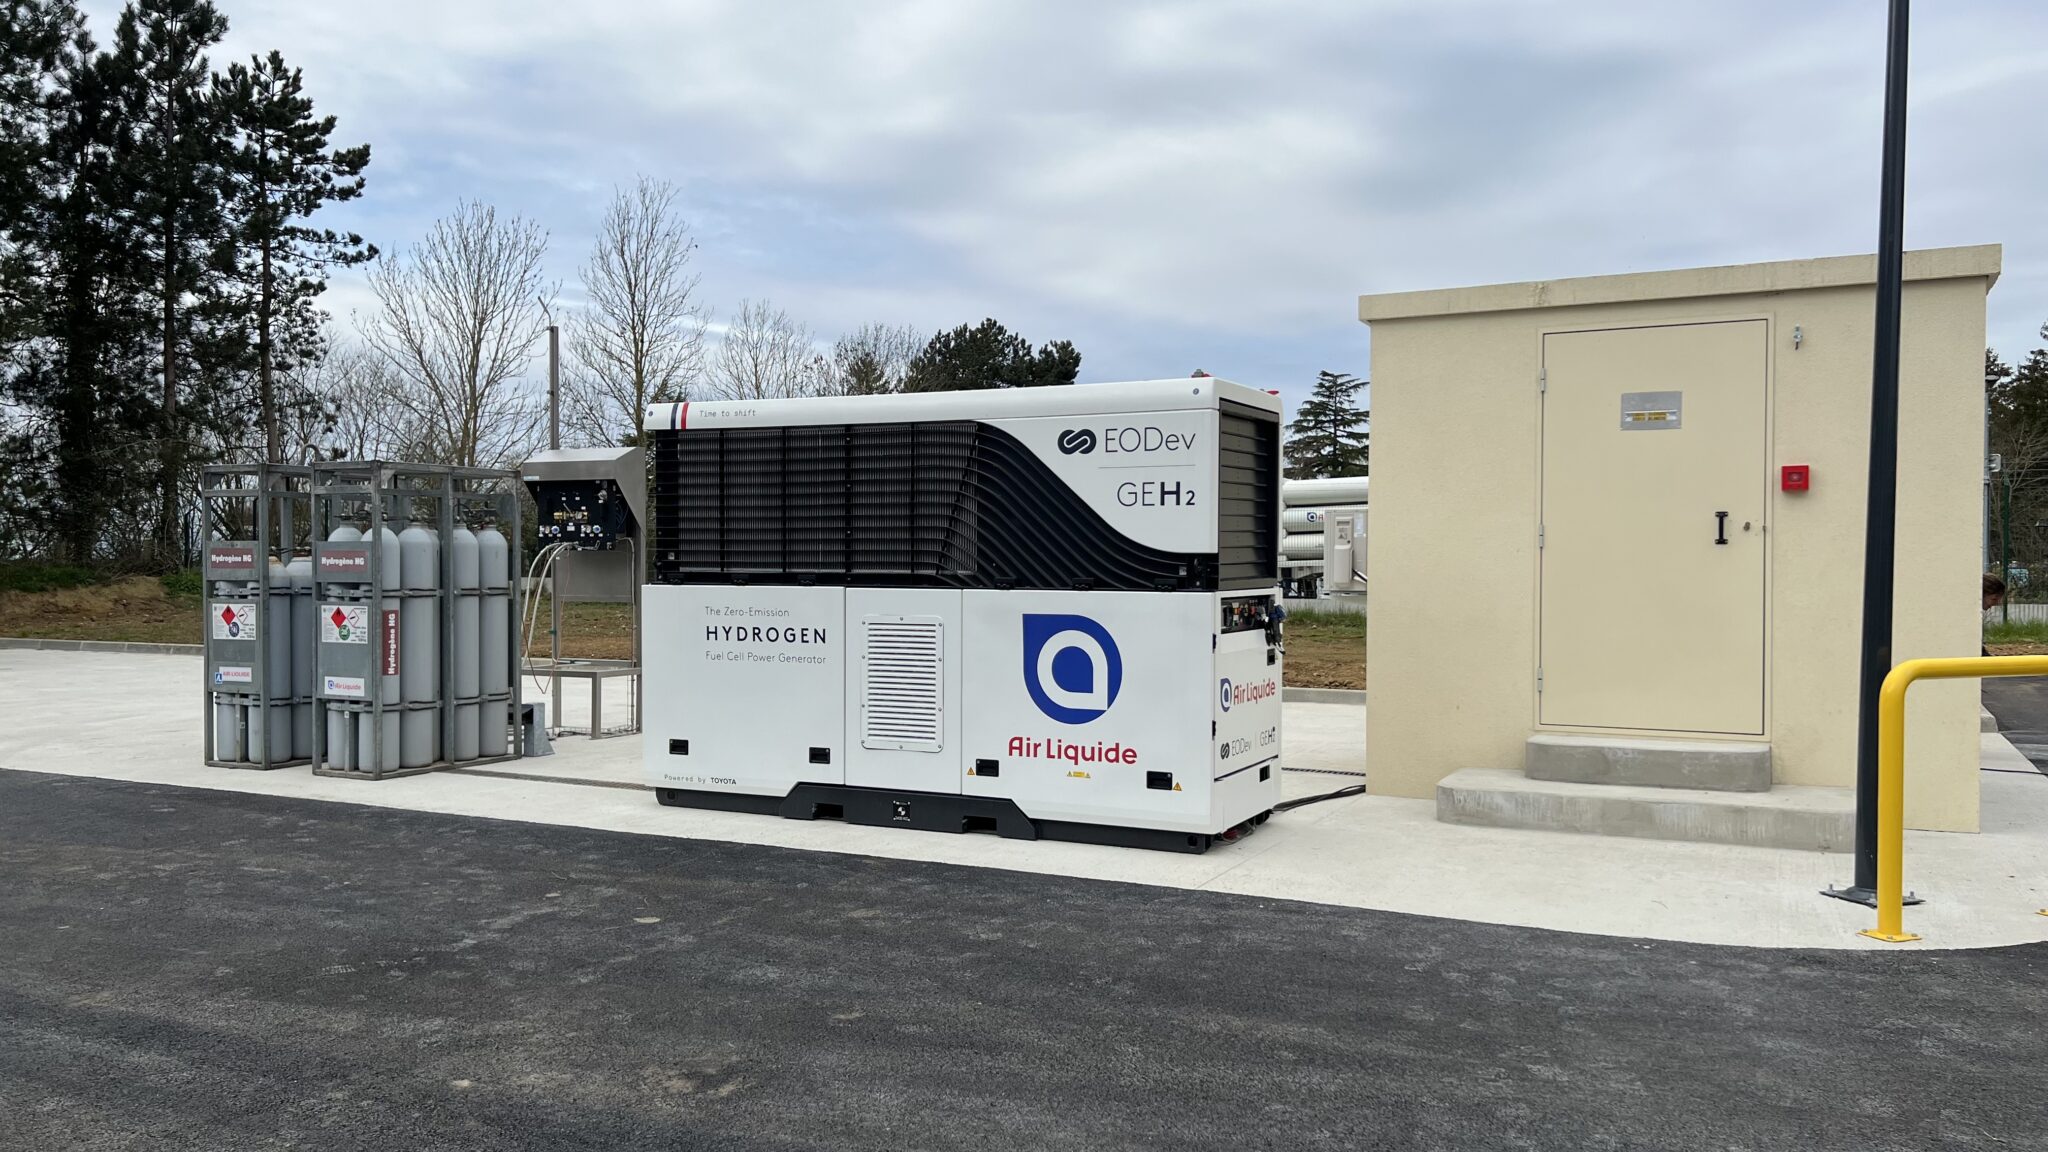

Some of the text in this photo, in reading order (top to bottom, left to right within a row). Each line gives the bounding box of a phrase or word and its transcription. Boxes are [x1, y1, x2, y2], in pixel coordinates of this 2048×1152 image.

[734, 409, 757, 417] shift
[1105, 426, 1196, 453] EODev
[1117, 481, 1196, 507] GEH2
[242, 554, 252, 562] HG
[354, 557, 365, 565] HG
[705, 606, 790, 617] The Zero-Emission
[388, 613, 396, 627] HG
[706, 626, 826, 644] HYDROGEN
[705, 651, 826, 664] Fuel Cell Power Generator
[1233, 677, 1276, 706] Air Liquide
[1008, 736, 1138, 765] Air Liquide
[1231, 737, 1252, 757] EODev
[664, 774, 737, 785] Powered by TOYOTA
